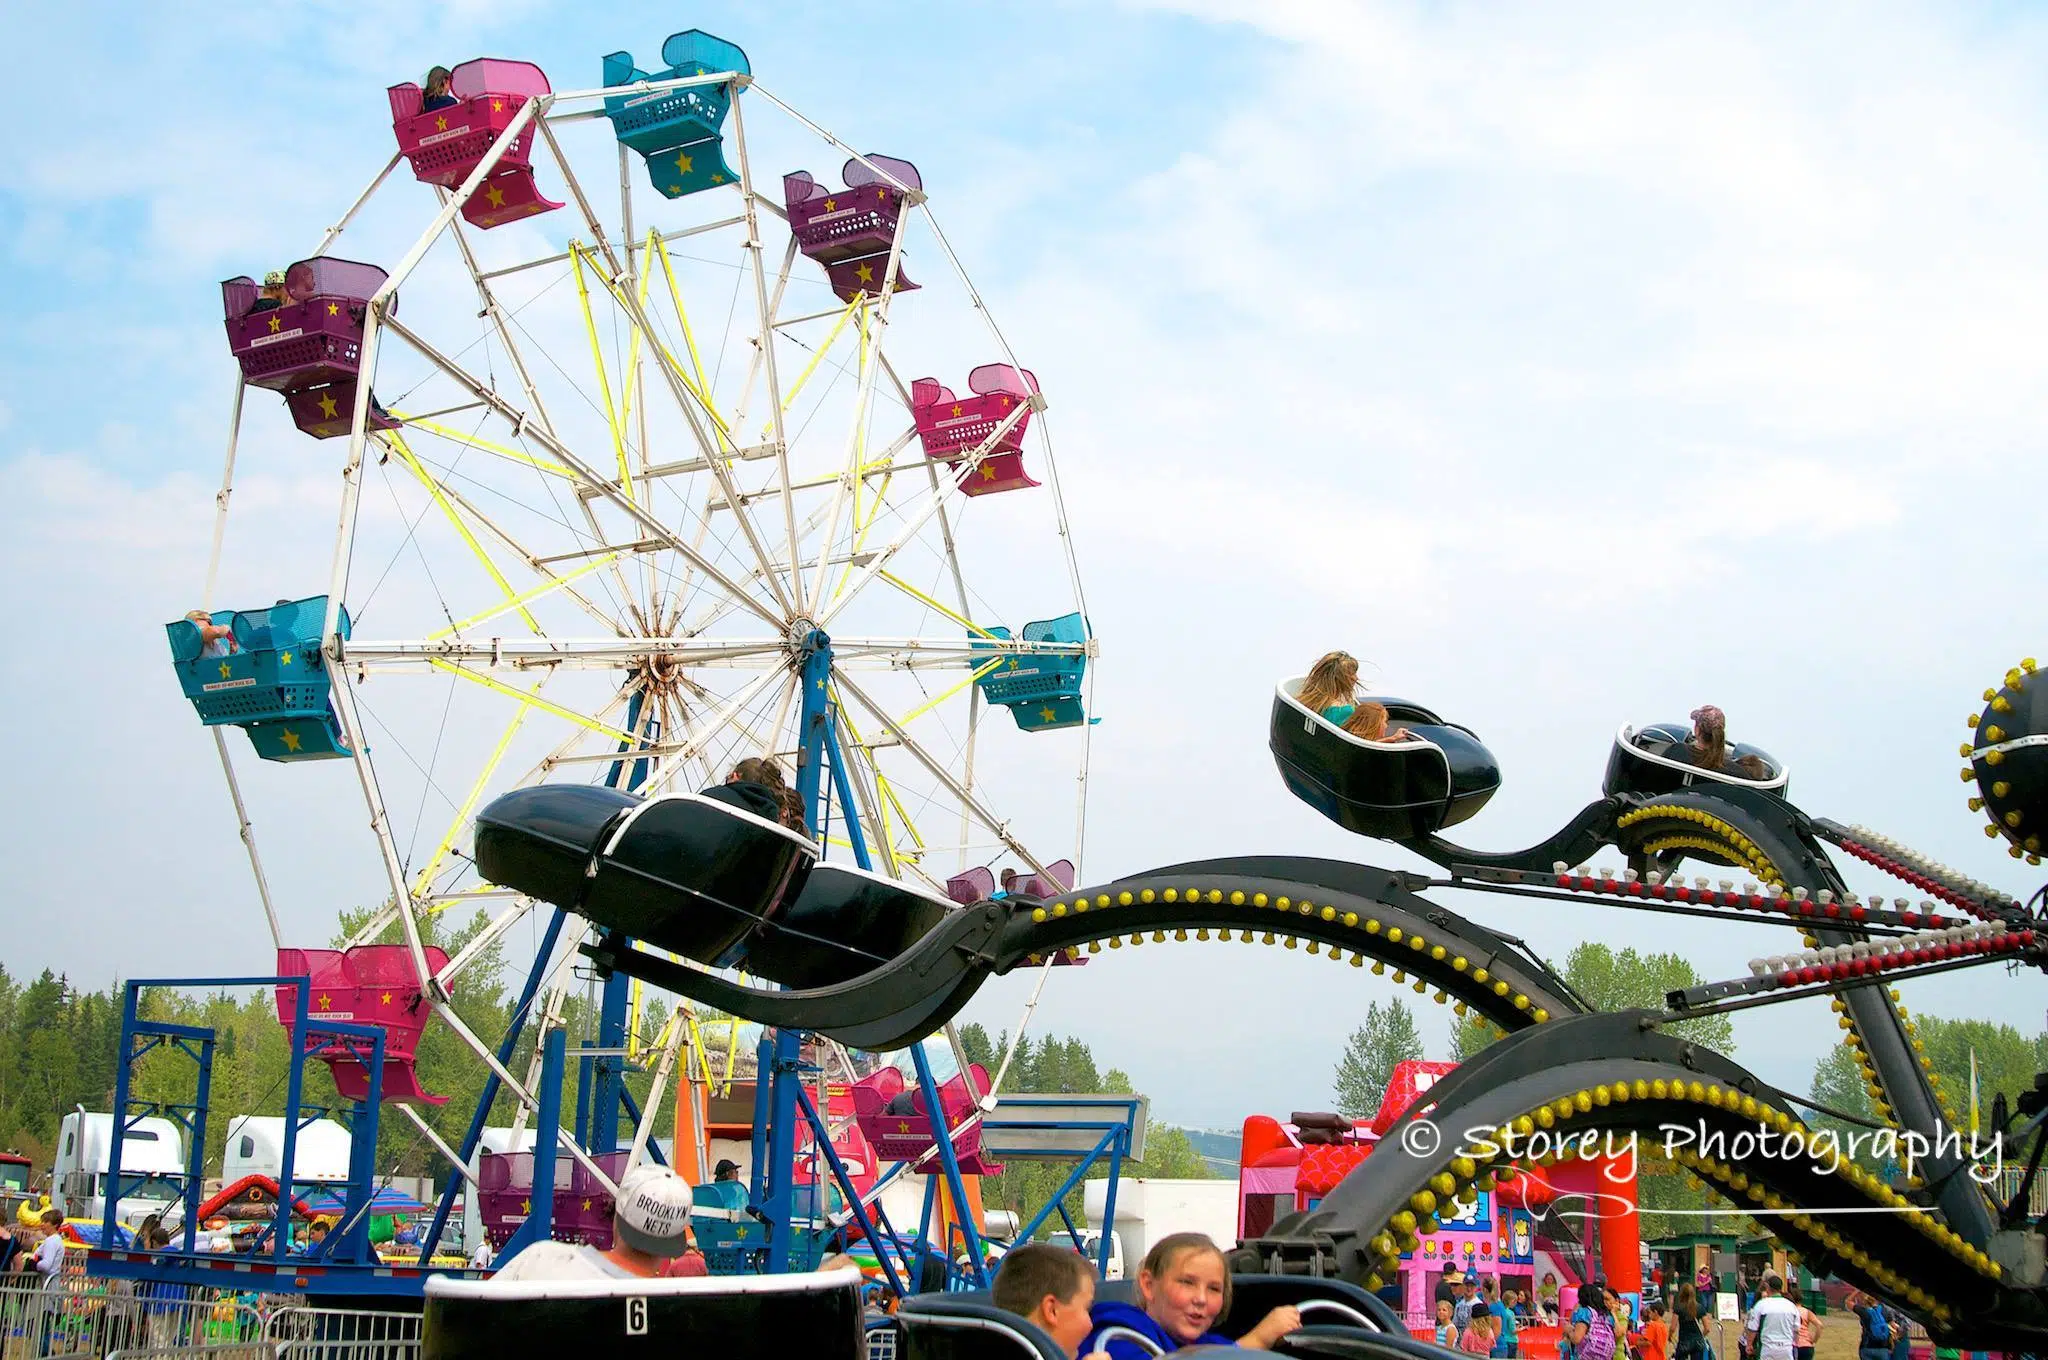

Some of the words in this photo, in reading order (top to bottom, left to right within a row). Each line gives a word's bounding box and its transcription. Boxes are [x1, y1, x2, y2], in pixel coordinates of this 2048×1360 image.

[636, 1193, 688, 1221] BROOKLYN
[643, 1216, 671, 1235] NETS
[630, 1300, 644, 1331] 6
